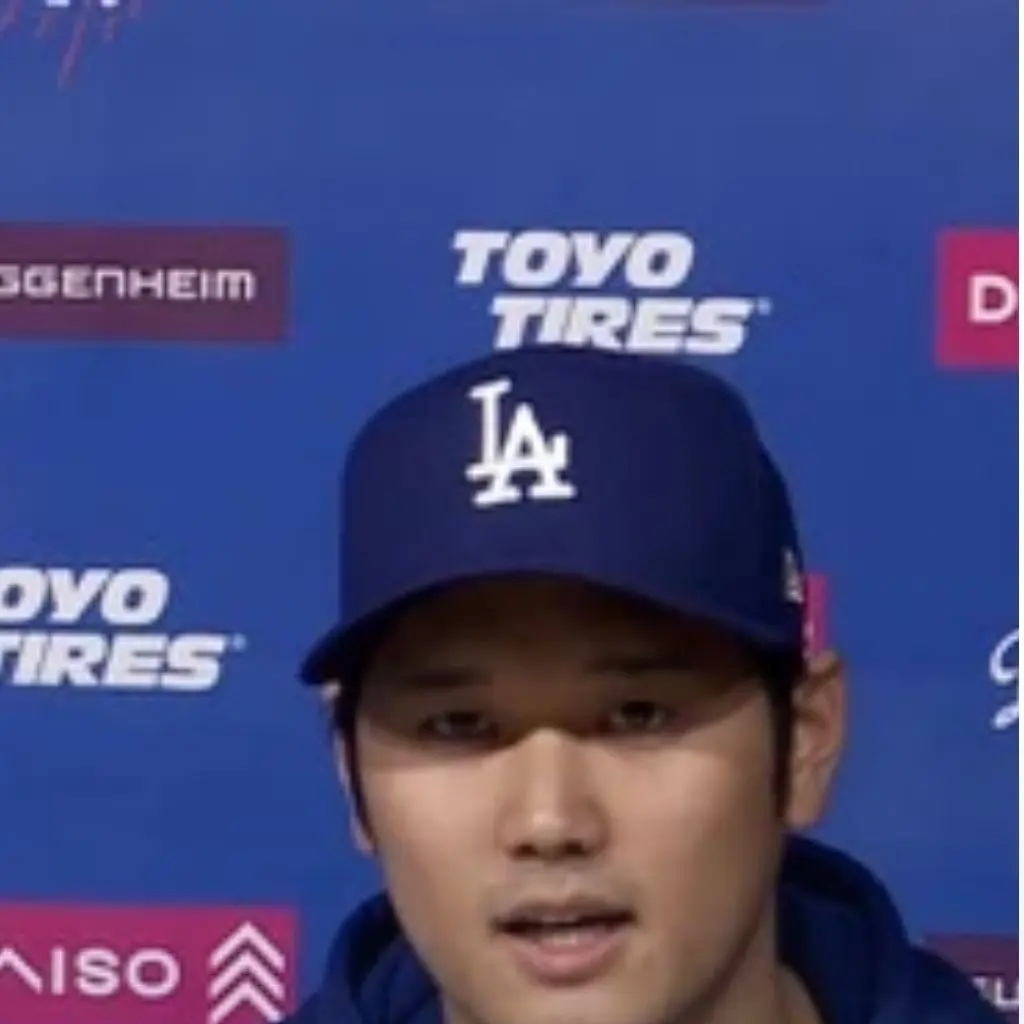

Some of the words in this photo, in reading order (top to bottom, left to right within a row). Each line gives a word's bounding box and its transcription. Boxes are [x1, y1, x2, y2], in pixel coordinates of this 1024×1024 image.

[452, 229, 695, 288] TOYO
[489, 296, 755, 355] TIRES
[465, 376, 578, 507] LA
